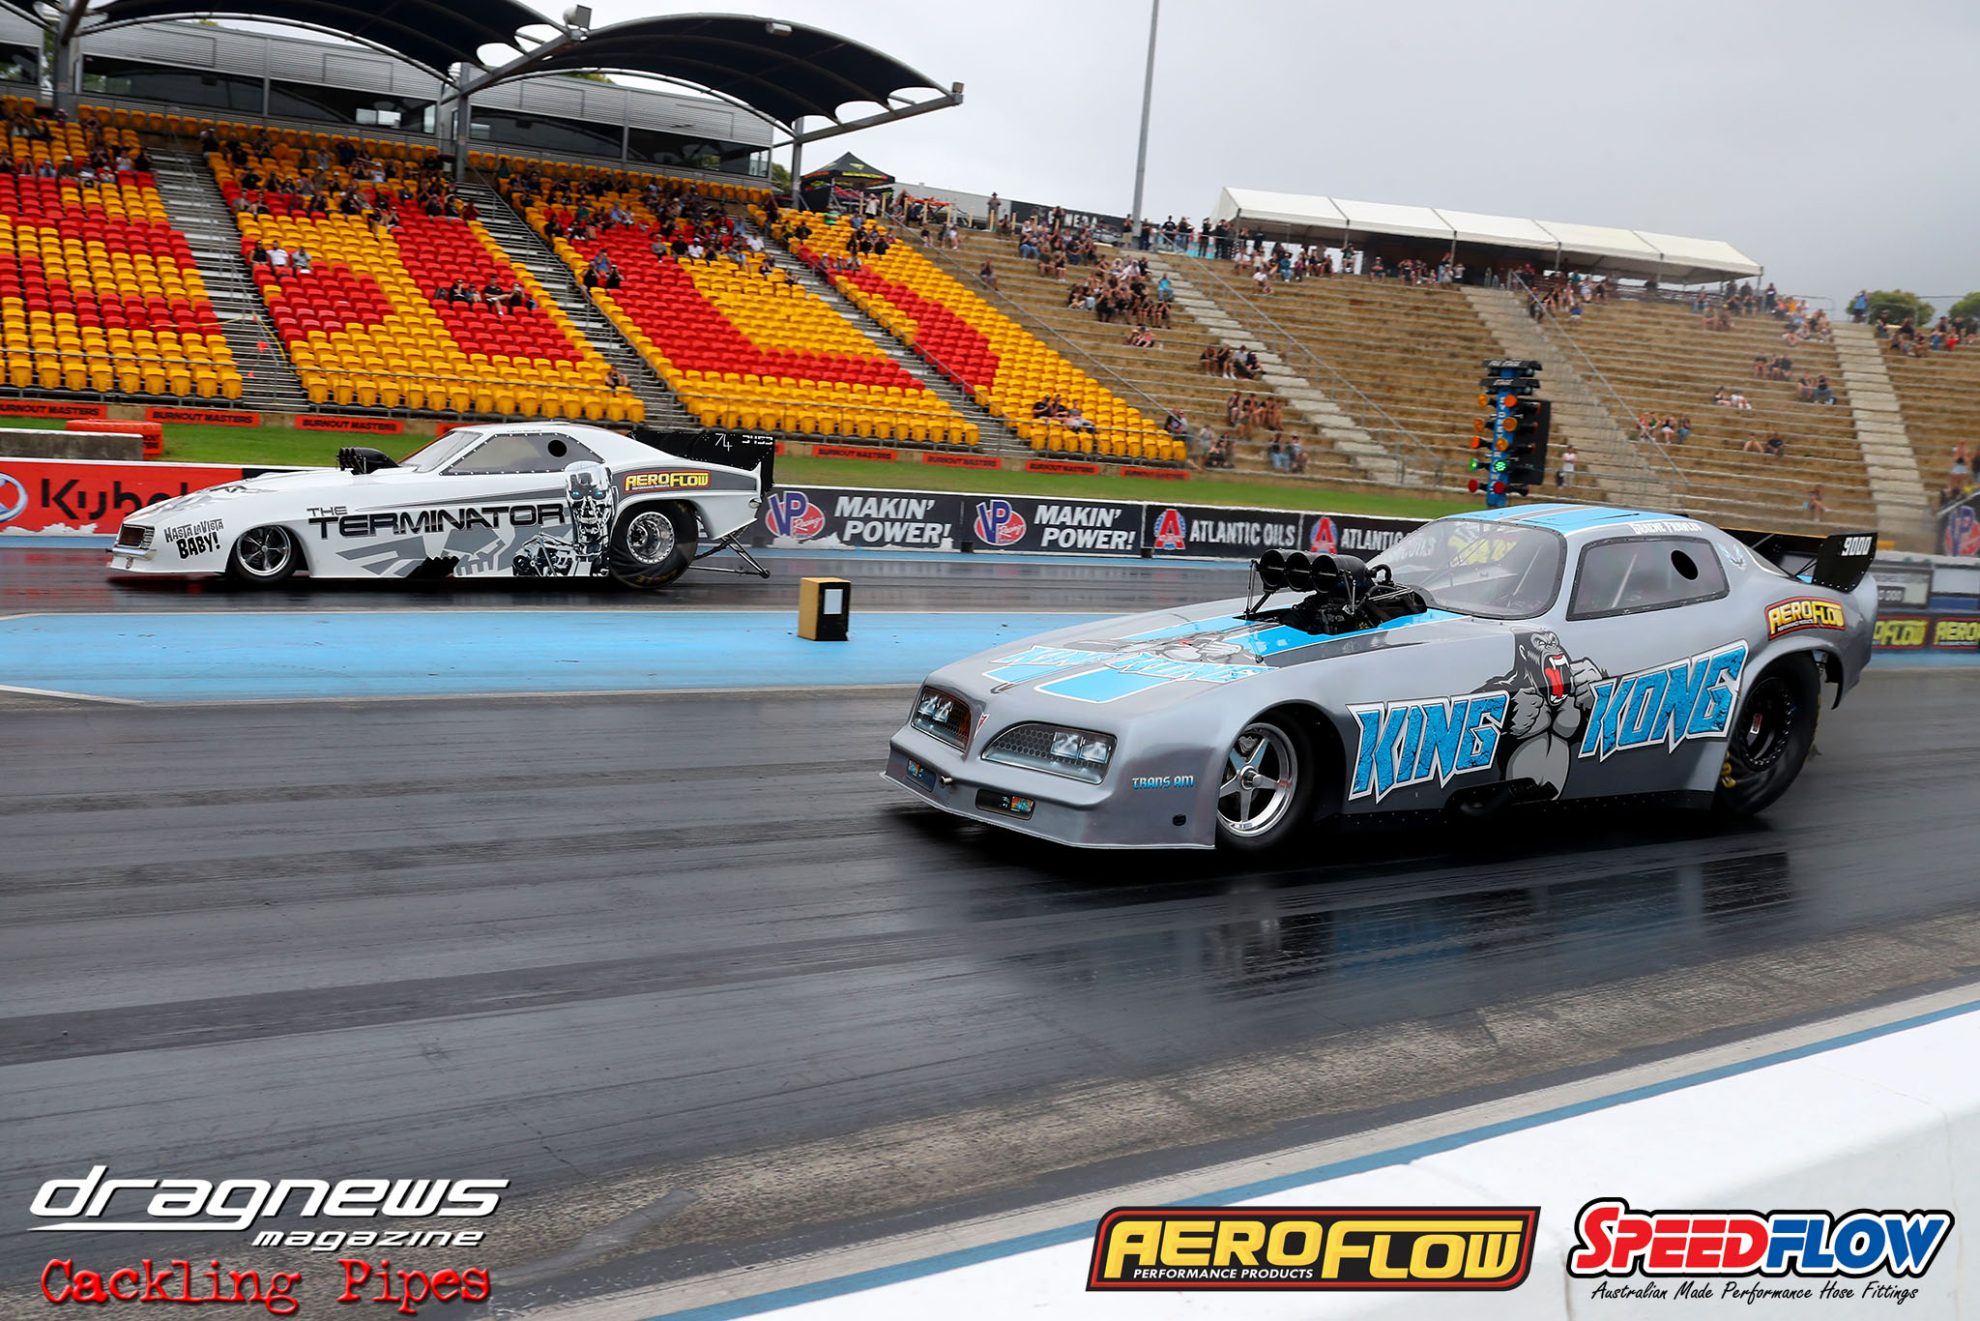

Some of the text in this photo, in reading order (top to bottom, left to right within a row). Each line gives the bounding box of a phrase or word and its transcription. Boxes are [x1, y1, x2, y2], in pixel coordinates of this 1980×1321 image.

[0, 404, 47, 413] URNOUT
[624, 472, 710, 491] AEROFLOW
[307, 505, 348, 517] THE
[308, 503, 566, 541] TERMINATOR
[767, 490, 809, 536] VP
[976, 500, 1013, 544] VP
[163, 523, 193, 543] HASTA
[200, 518, 224, 533] VISTA
[842, 520, 951, 544] POWER!
[1040, 527, 1136, 550] POWER!
[1189, 519, 1296, 547] ATLANTIC OILS
[176, 531, 221, 560] BABY!
[1841, 536, 1873, 557] 9000
[1768, 600, 1845, 635] AEROFLOW
[1933, 621, 1980, 646] AERO
[1578, 640, 1750, 763] KONG
[1346, 690, 1511, 805] KING
[1132, 777, 1171, 790] TRANS
